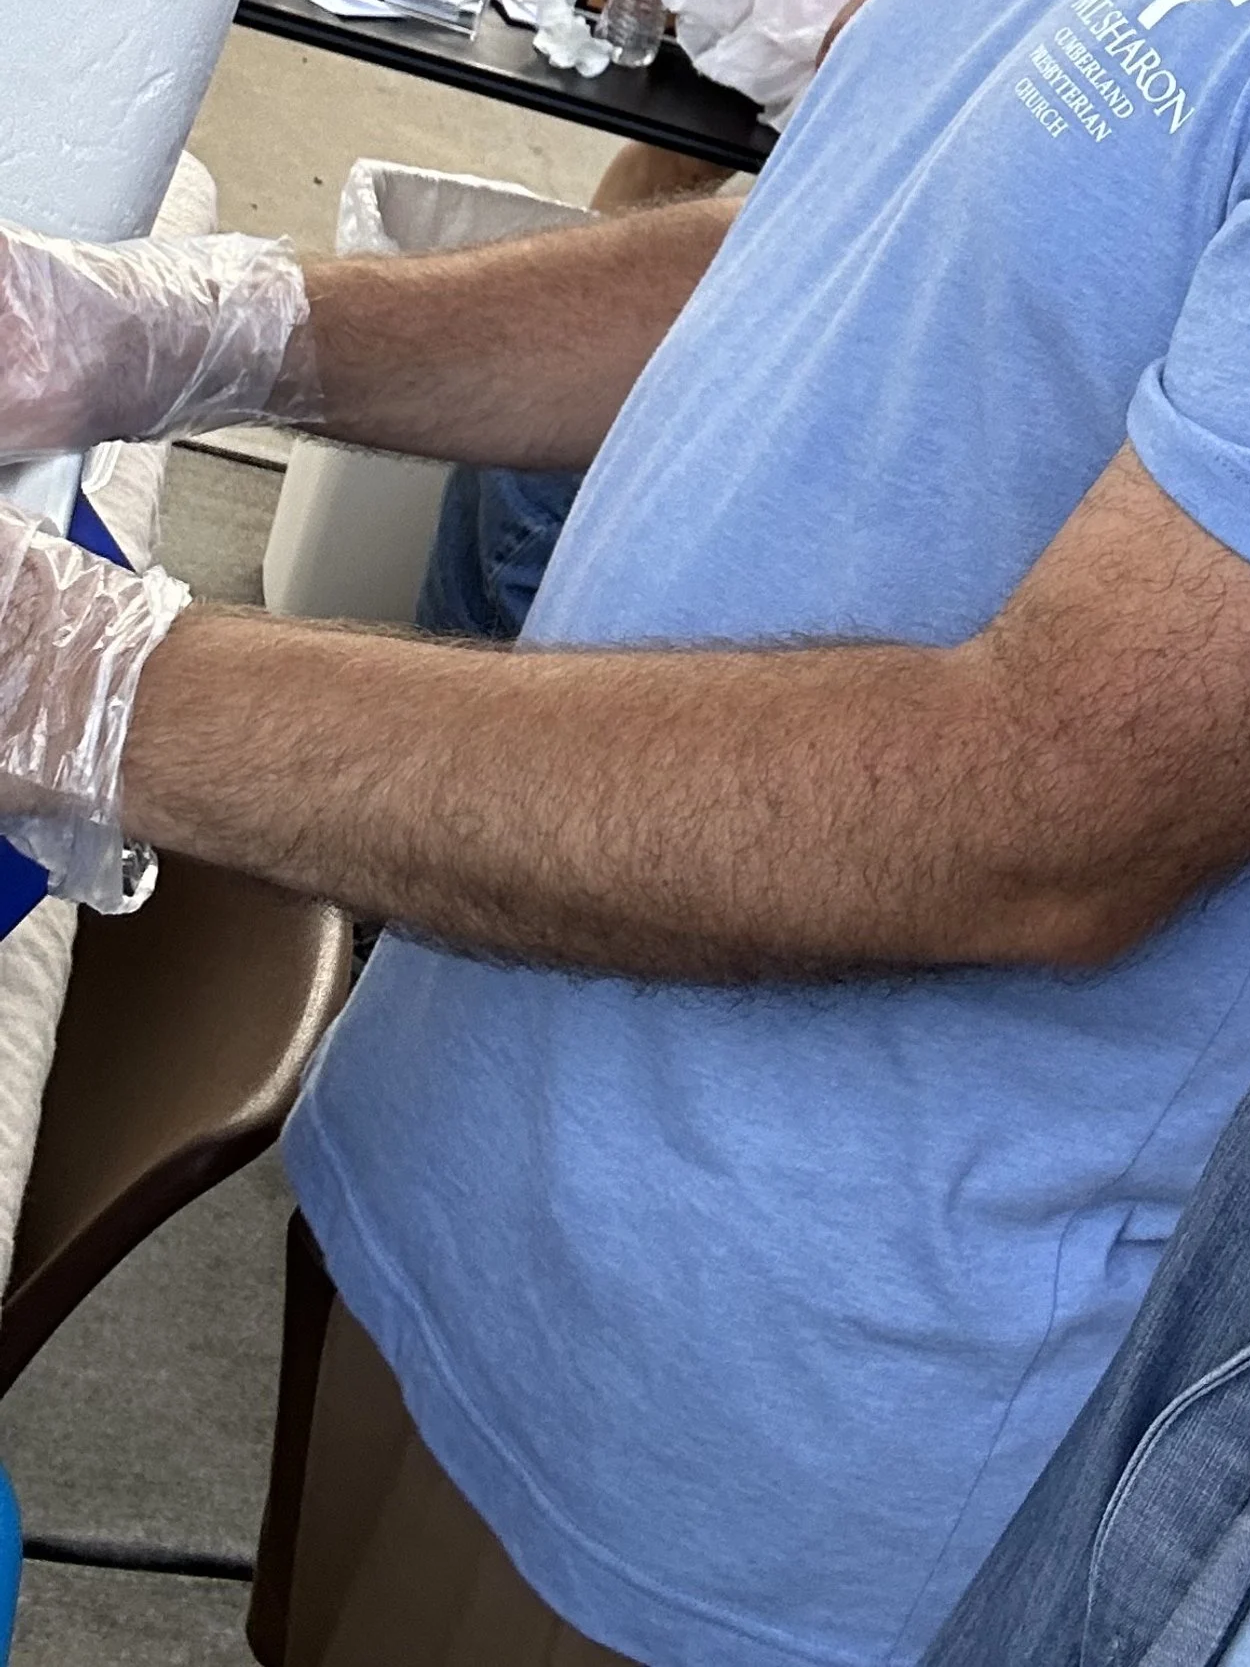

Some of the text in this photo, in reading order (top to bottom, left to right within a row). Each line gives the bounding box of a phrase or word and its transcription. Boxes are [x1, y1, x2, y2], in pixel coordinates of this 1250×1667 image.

[1014, 77, 1069, 138] CHURCH
[1029, 43, 1112, 143] PRESBYTERIAN
[1054, 27, 1134, 119] CUMBERLAND
[1090, 10, 1195, 135] SHARON
